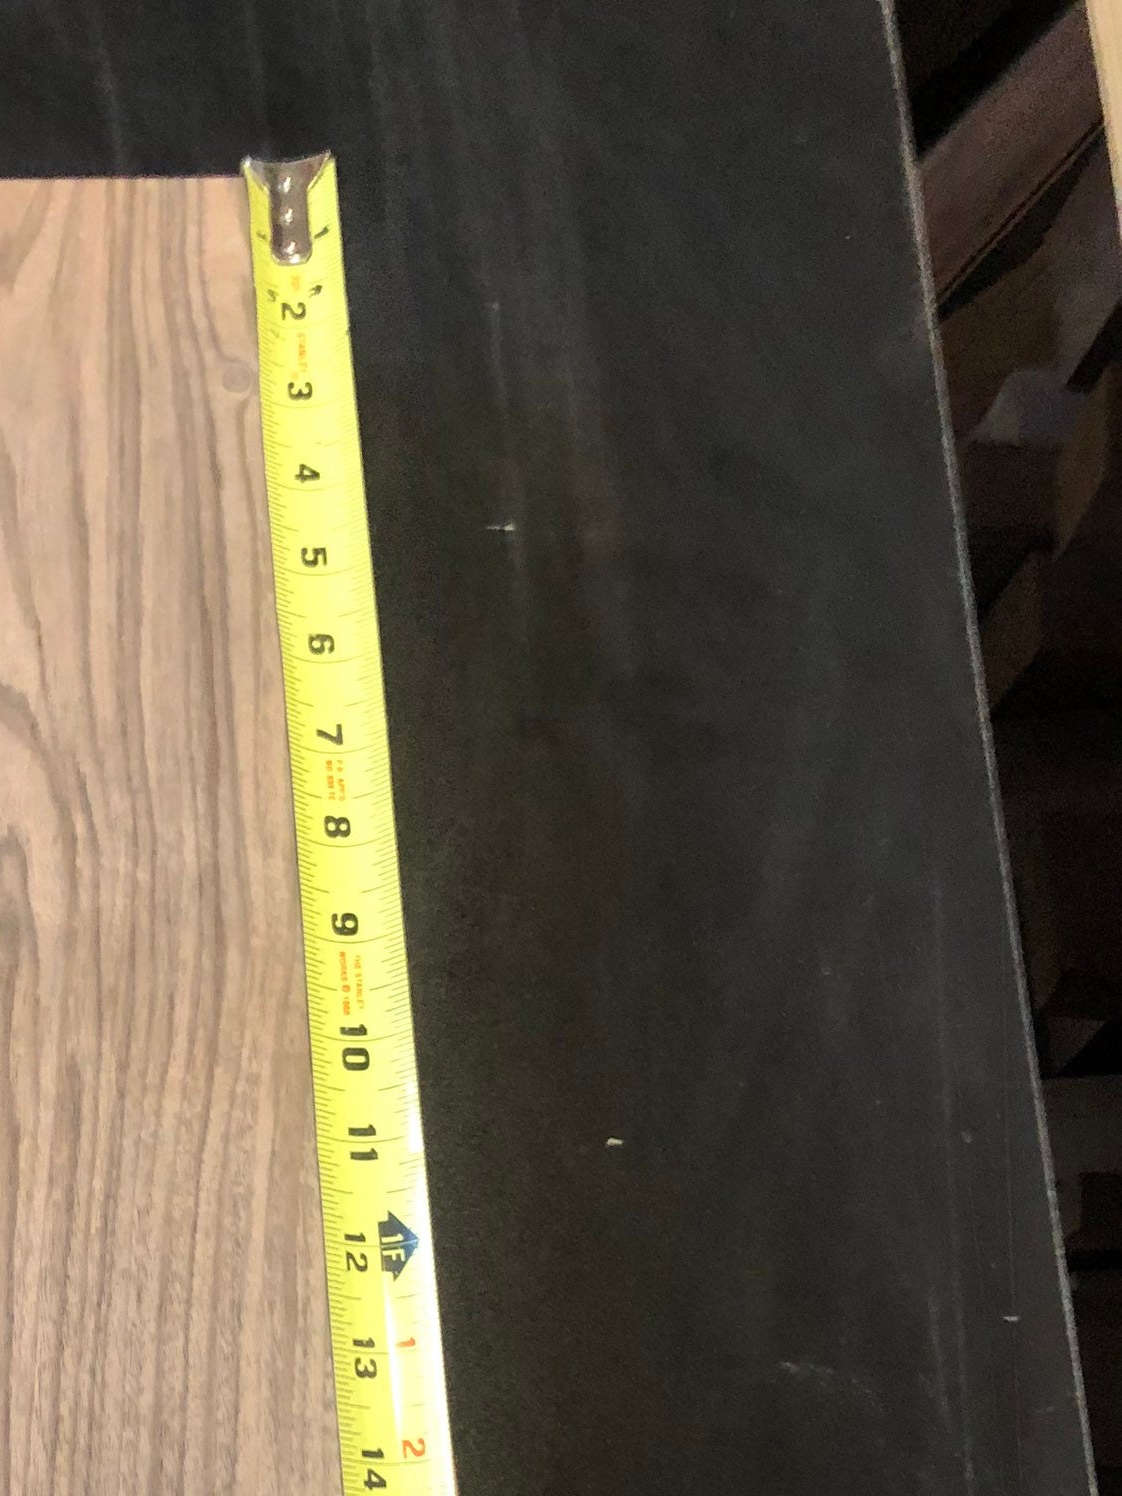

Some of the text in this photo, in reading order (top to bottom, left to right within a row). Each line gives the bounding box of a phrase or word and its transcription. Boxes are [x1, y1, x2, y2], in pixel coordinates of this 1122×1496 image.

[281, 302, 307, 321] 2
[287, 381, 313, 401] 3
[294, 464, 320, 484] 4
[301, 547, 328, 568] 5
[308, 633, 335, 655] 6
[316, 723, 344, 746] 7
[324, 815, 351, 838] 8
[331, 912, 359, 936] 9
[339, 951, 349, 982] WORKS
[340, 1024, 370, 1071] 10
[348, 1124, 378, 1161] 11
[344, 1232, 368, 1272] 12
[380, 1233, 405, 1263] 1F
[396, 1337, 416, 1348] 1
[353, 1337, 377, 1379] 13
[402, 1438, 425, 1458] 2
[362, 1448, 387, 1490] 14
